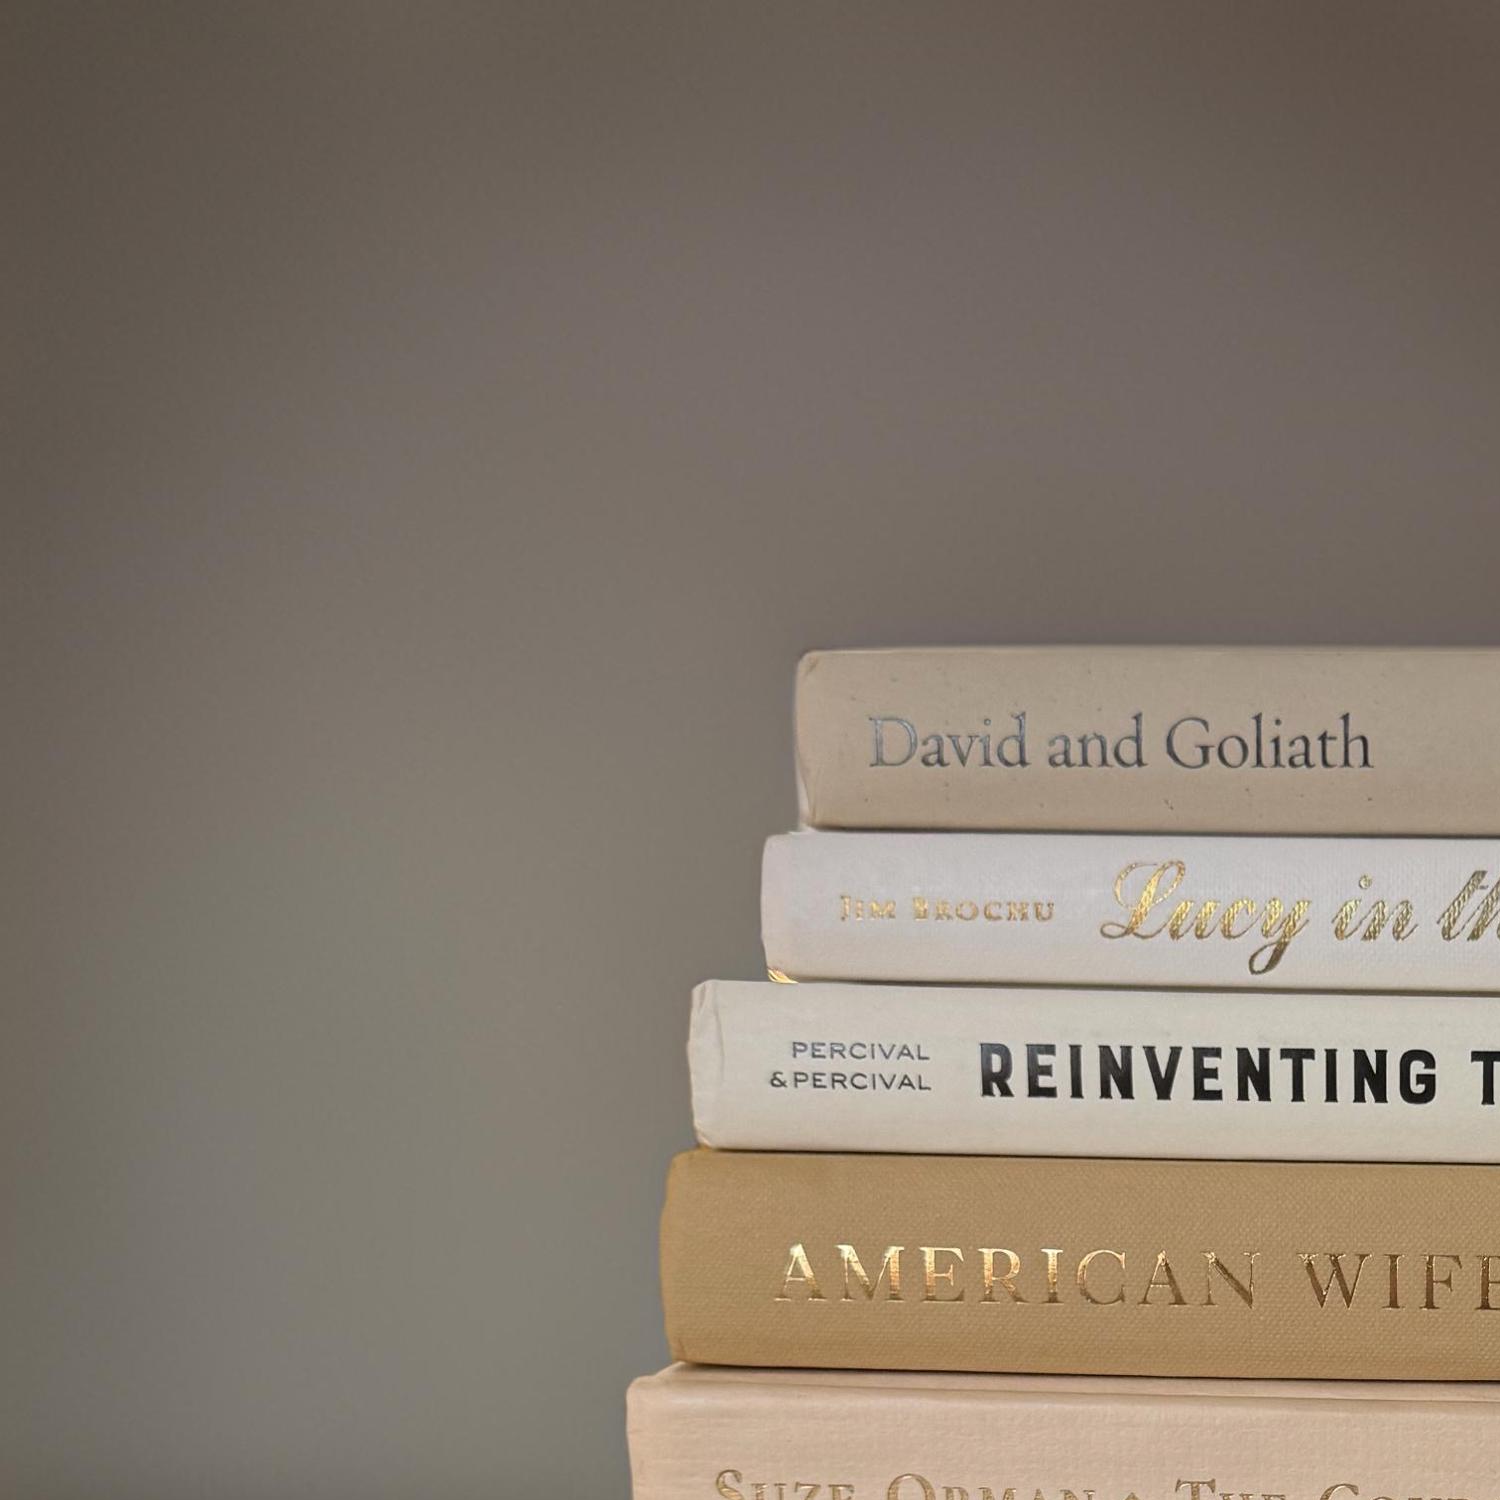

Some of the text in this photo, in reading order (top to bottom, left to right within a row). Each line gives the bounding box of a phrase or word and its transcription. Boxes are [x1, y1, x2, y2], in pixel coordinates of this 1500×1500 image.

[868, 713, 1375, 772] David and Goliath
[839, 895, 1056, 922] JIM BROCHU
[1100, 860, 1309, 976] Lucy
[1333, 874, 1420, 944] in
[792, 1042, 931, 1061] PERCIVAL
[979, 1042, 1438, 1105] REINVENTING
[774, 1243, 1261, 1310] AMERICAN
